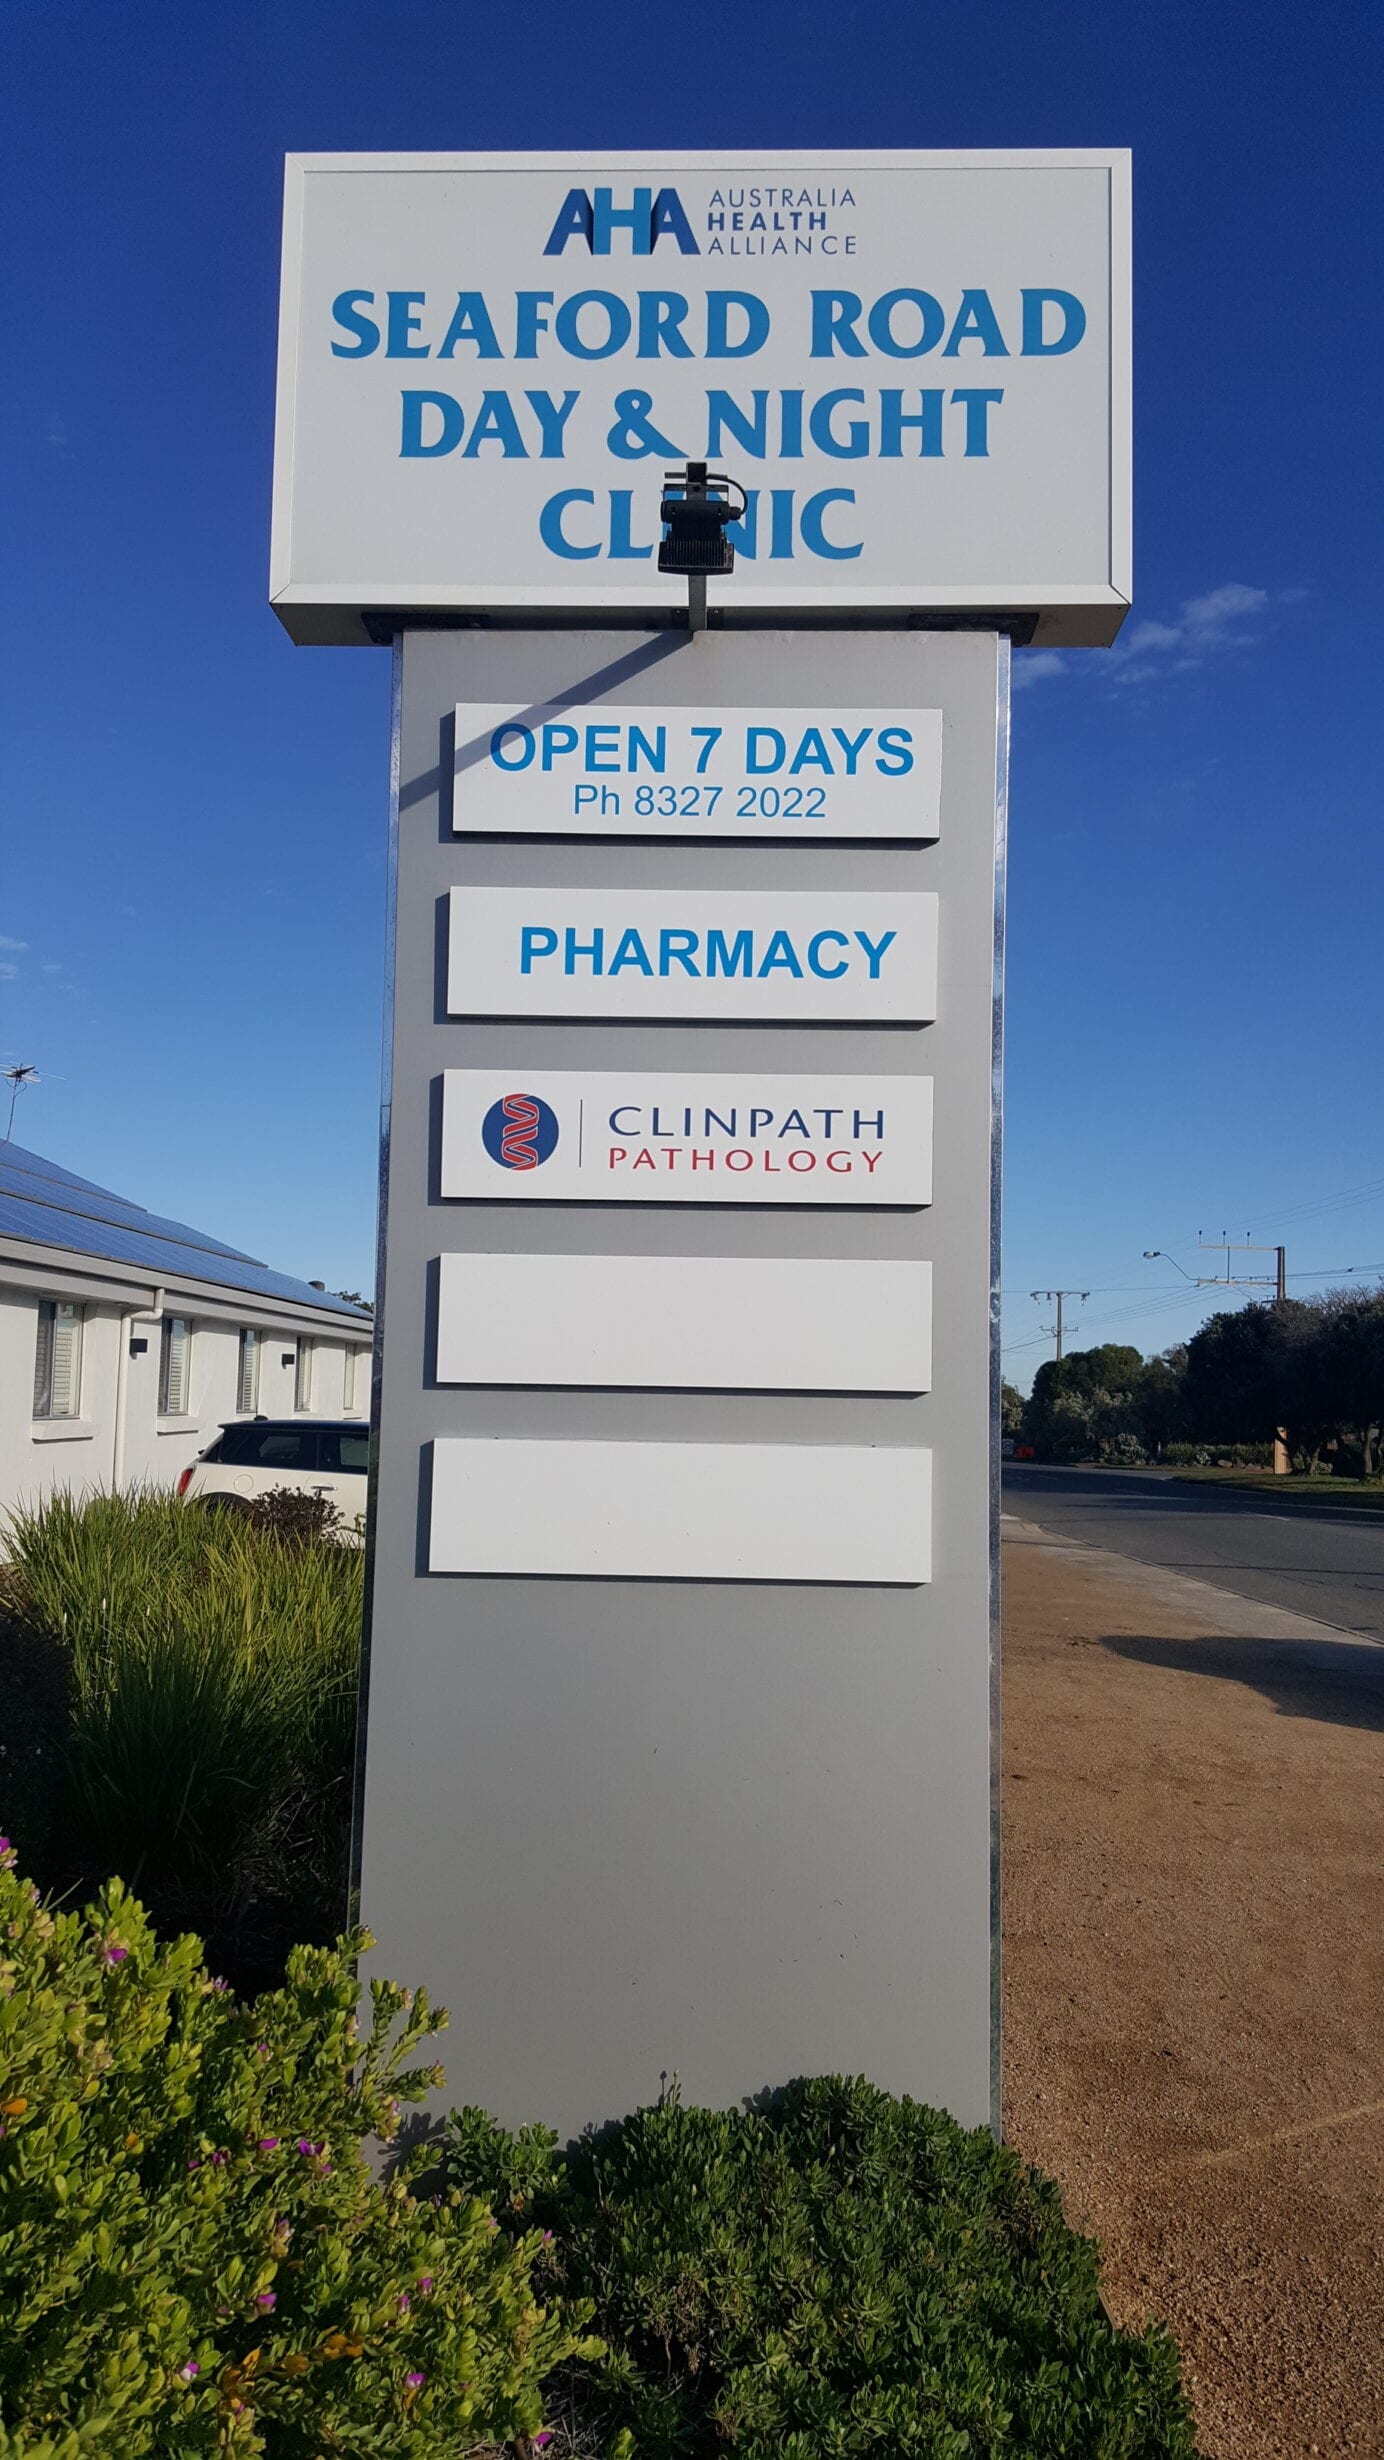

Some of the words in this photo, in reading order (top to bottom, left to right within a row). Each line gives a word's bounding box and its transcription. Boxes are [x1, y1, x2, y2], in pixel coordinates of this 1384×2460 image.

[708, 187, 856, 208] AUSTRALIA
[542, 187, 701, 256] AHA
[707, 211, 827, 232] HEALTH
[707, 235, 857, 256] ALLIANCE
[330, 288, 771, 361] SEAFORD
[809, 287, 1087, 360] ROAD
[398, 389, 581, 459] DAY
[606, 388, 688, 460] &
[706, 387, 1005, 460] NIGHT
[490, 723, 667, 774] OPEN
[690, 726, 723, 775] 7
[745, 726, 915, 777] DAYS
[574, 783, 620, 816] Ph
[633, 784, 724, 818] 8327
[735, 786, 827, 819] 2022
[519, 926, 898, 980] PHARMACY
[607, 1105, 885, 1140] CLINPATH
[608, 1146, 885, 1174] PATHOLOGY
